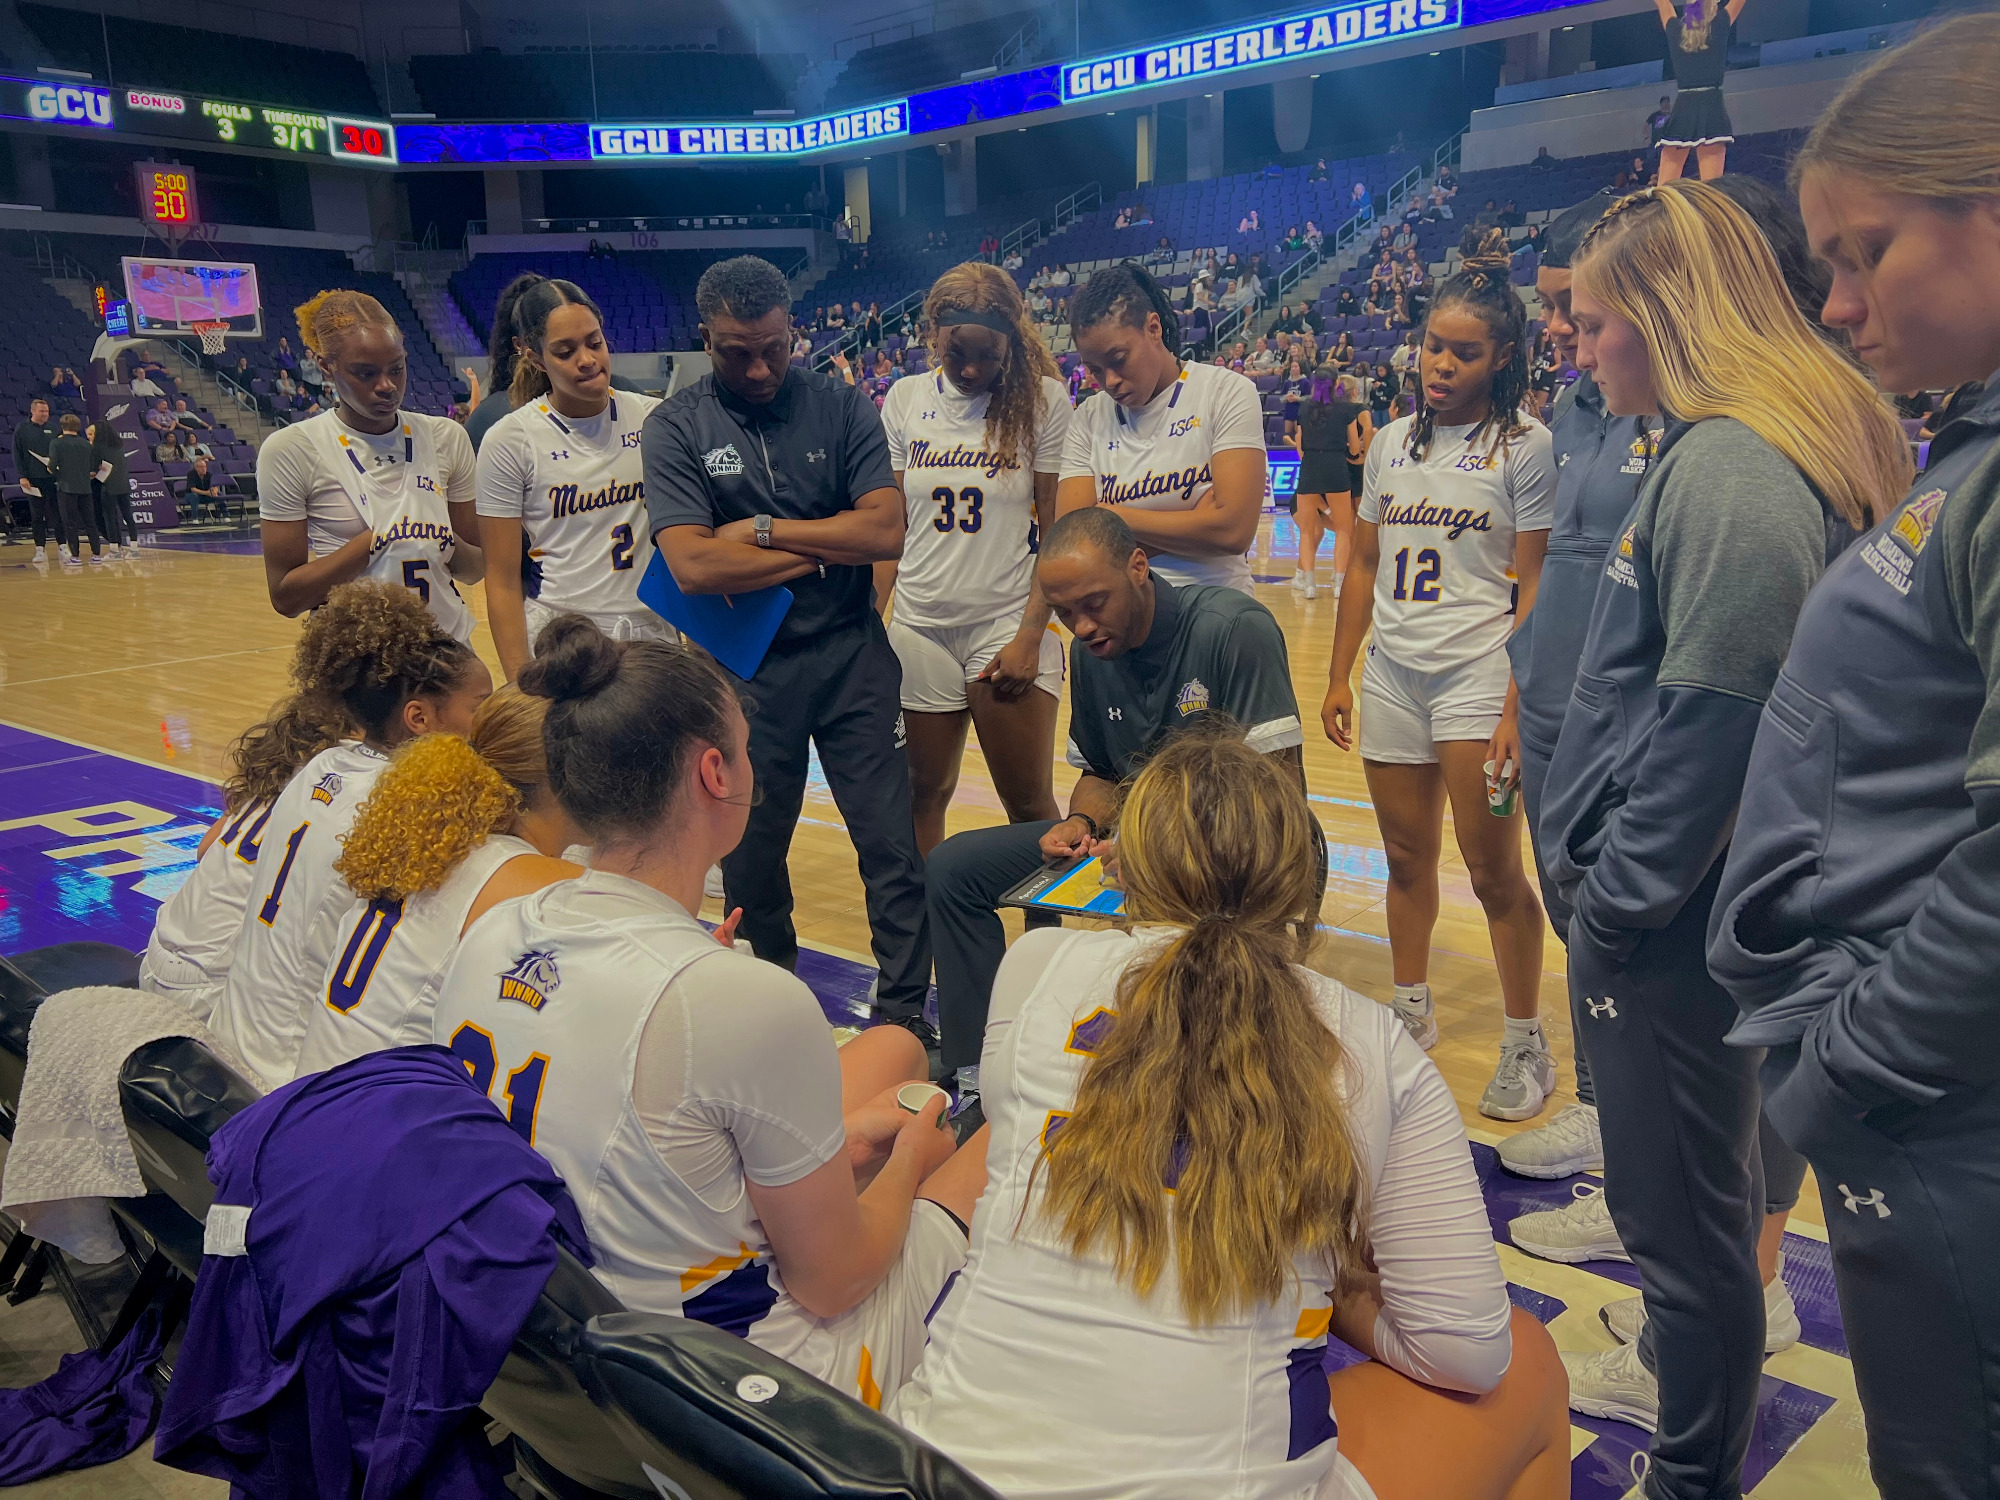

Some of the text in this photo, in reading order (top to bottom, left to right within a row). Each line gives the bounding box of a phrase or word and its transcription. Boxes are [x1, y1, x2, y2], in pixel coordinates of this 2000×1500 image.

[1070, 0, 1447, 97] GCU CHEERLEADERS
[29, 86, 111, 124] GCU
[130, 94, 183, 111] BONUS
[202, 102, 252, 121] FOULS
[218, 119, 236, 140] 3
[262, 109, 327, 131] TIMEOUTS
[600, 105, 902, 154] GCU CHEERLEADERS
[273, 124, 315, 151] 3/1
[342, 125, 383, 155] 30
[154, 173, 187, 192] 5:00
[153, 191, 186, 219] 30
[630, 231, 659, 249] 106
[706, 463, 739, 474] WNMU
[1099, 462, 1213, 505] Mustangs
[548, 478, 648, 519] Mustan
[932, 486, 984, 534] 33
[132, 511, 154, 524] CU
[1377, 493, 1493, 541] Mustangs
[610, 522, 634, 572] 2
[401, 559, 430, 604] 5
[1393, 546, 1442, 603] 12
[1180, 700, 1208, 714] WNMU
[258, 820, 311, 929] 1
[326, 897, 406, 1017] 0
[502, 978, 543, 1008] WNMU
